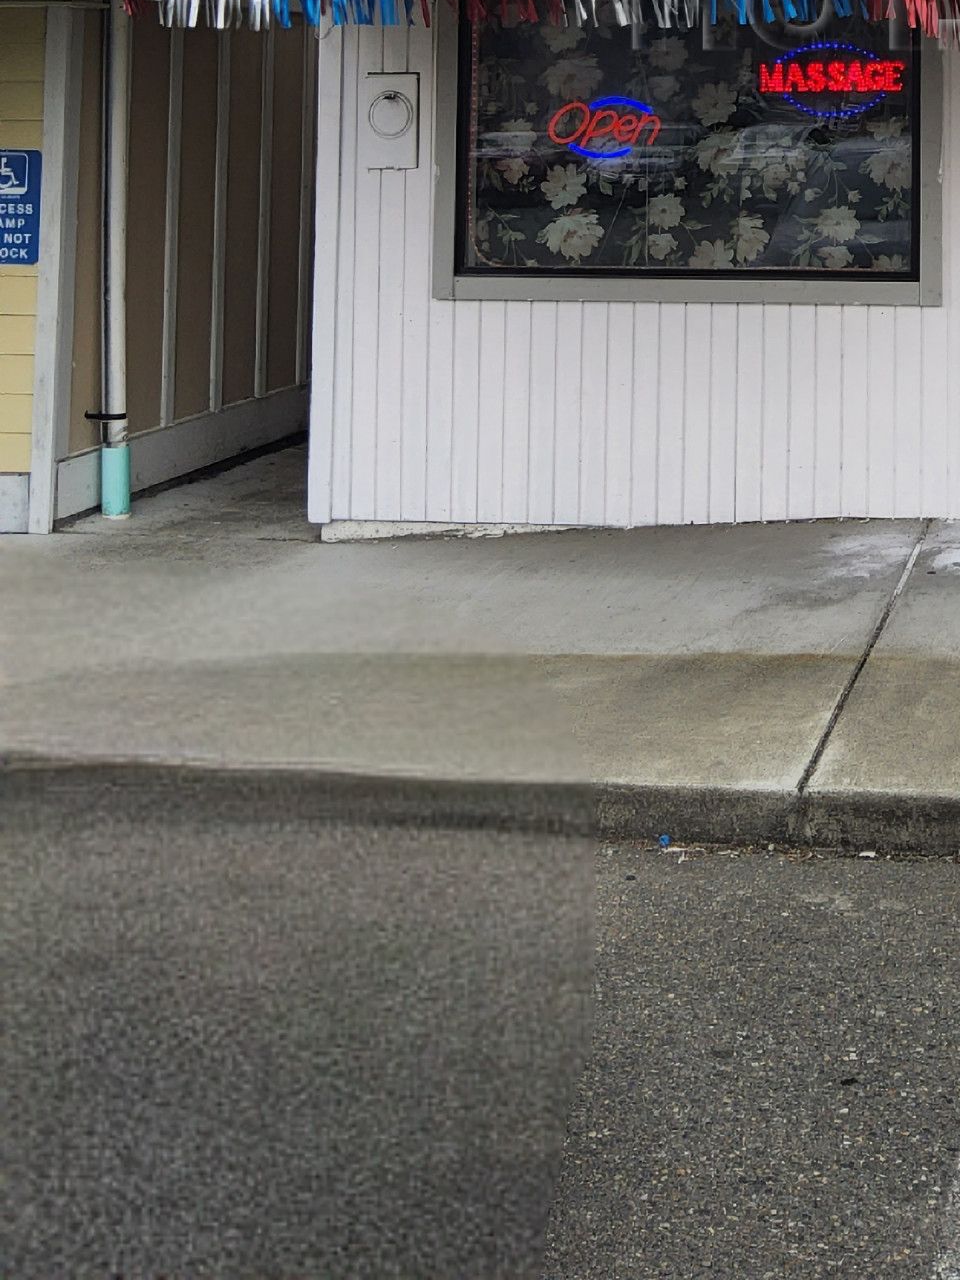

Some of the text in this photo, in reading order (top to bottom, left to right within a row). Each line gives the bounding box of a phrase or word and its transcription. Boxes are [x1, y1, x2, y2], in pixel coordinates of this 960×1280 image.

[758, 60, 904, 93] MASSAGE
[548, 99, 661, 148] Open
[4, 232, 32, 244] NOT
